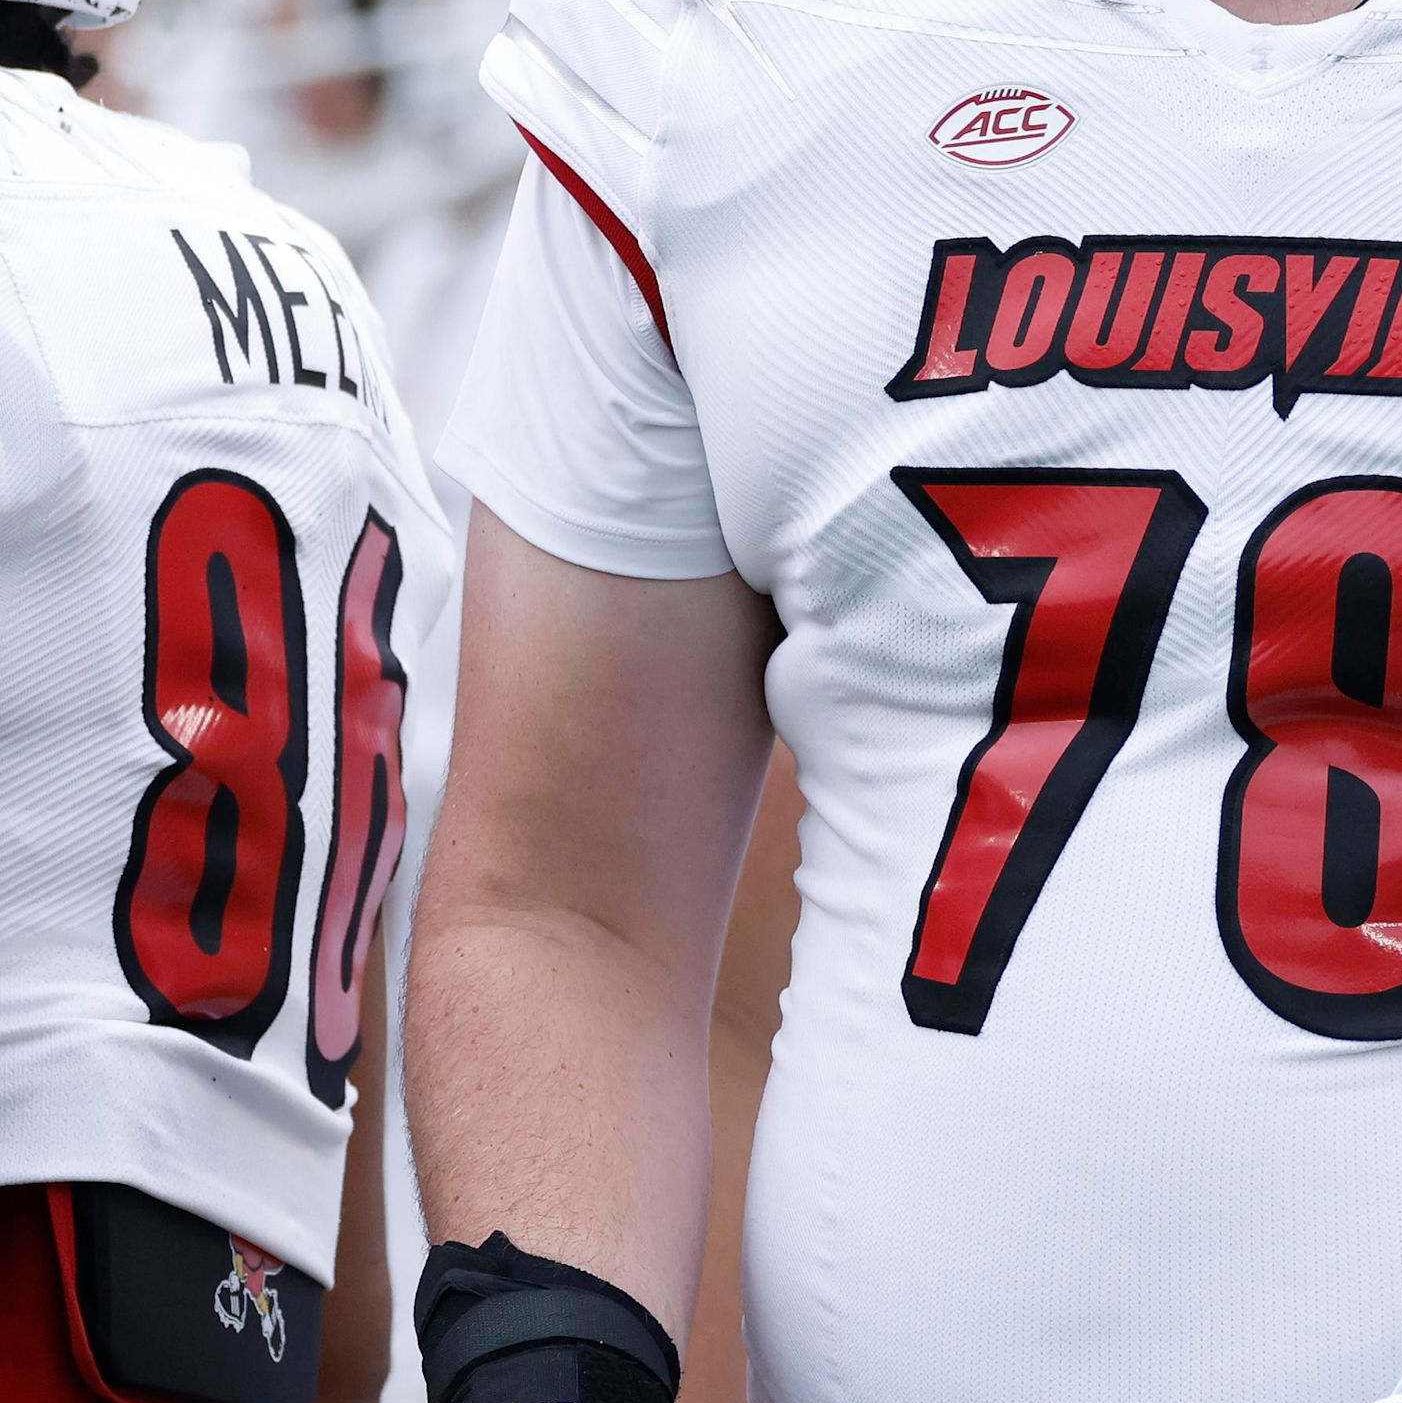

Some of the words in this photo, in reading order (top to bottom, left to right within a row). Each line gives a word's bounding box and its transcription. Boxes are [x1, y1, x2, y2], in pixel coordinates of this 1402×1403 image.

[959, 102, 1054, 138] ACC
[170, 228, 382, 423] MEE
[112, 466, 408, 1111] 86
